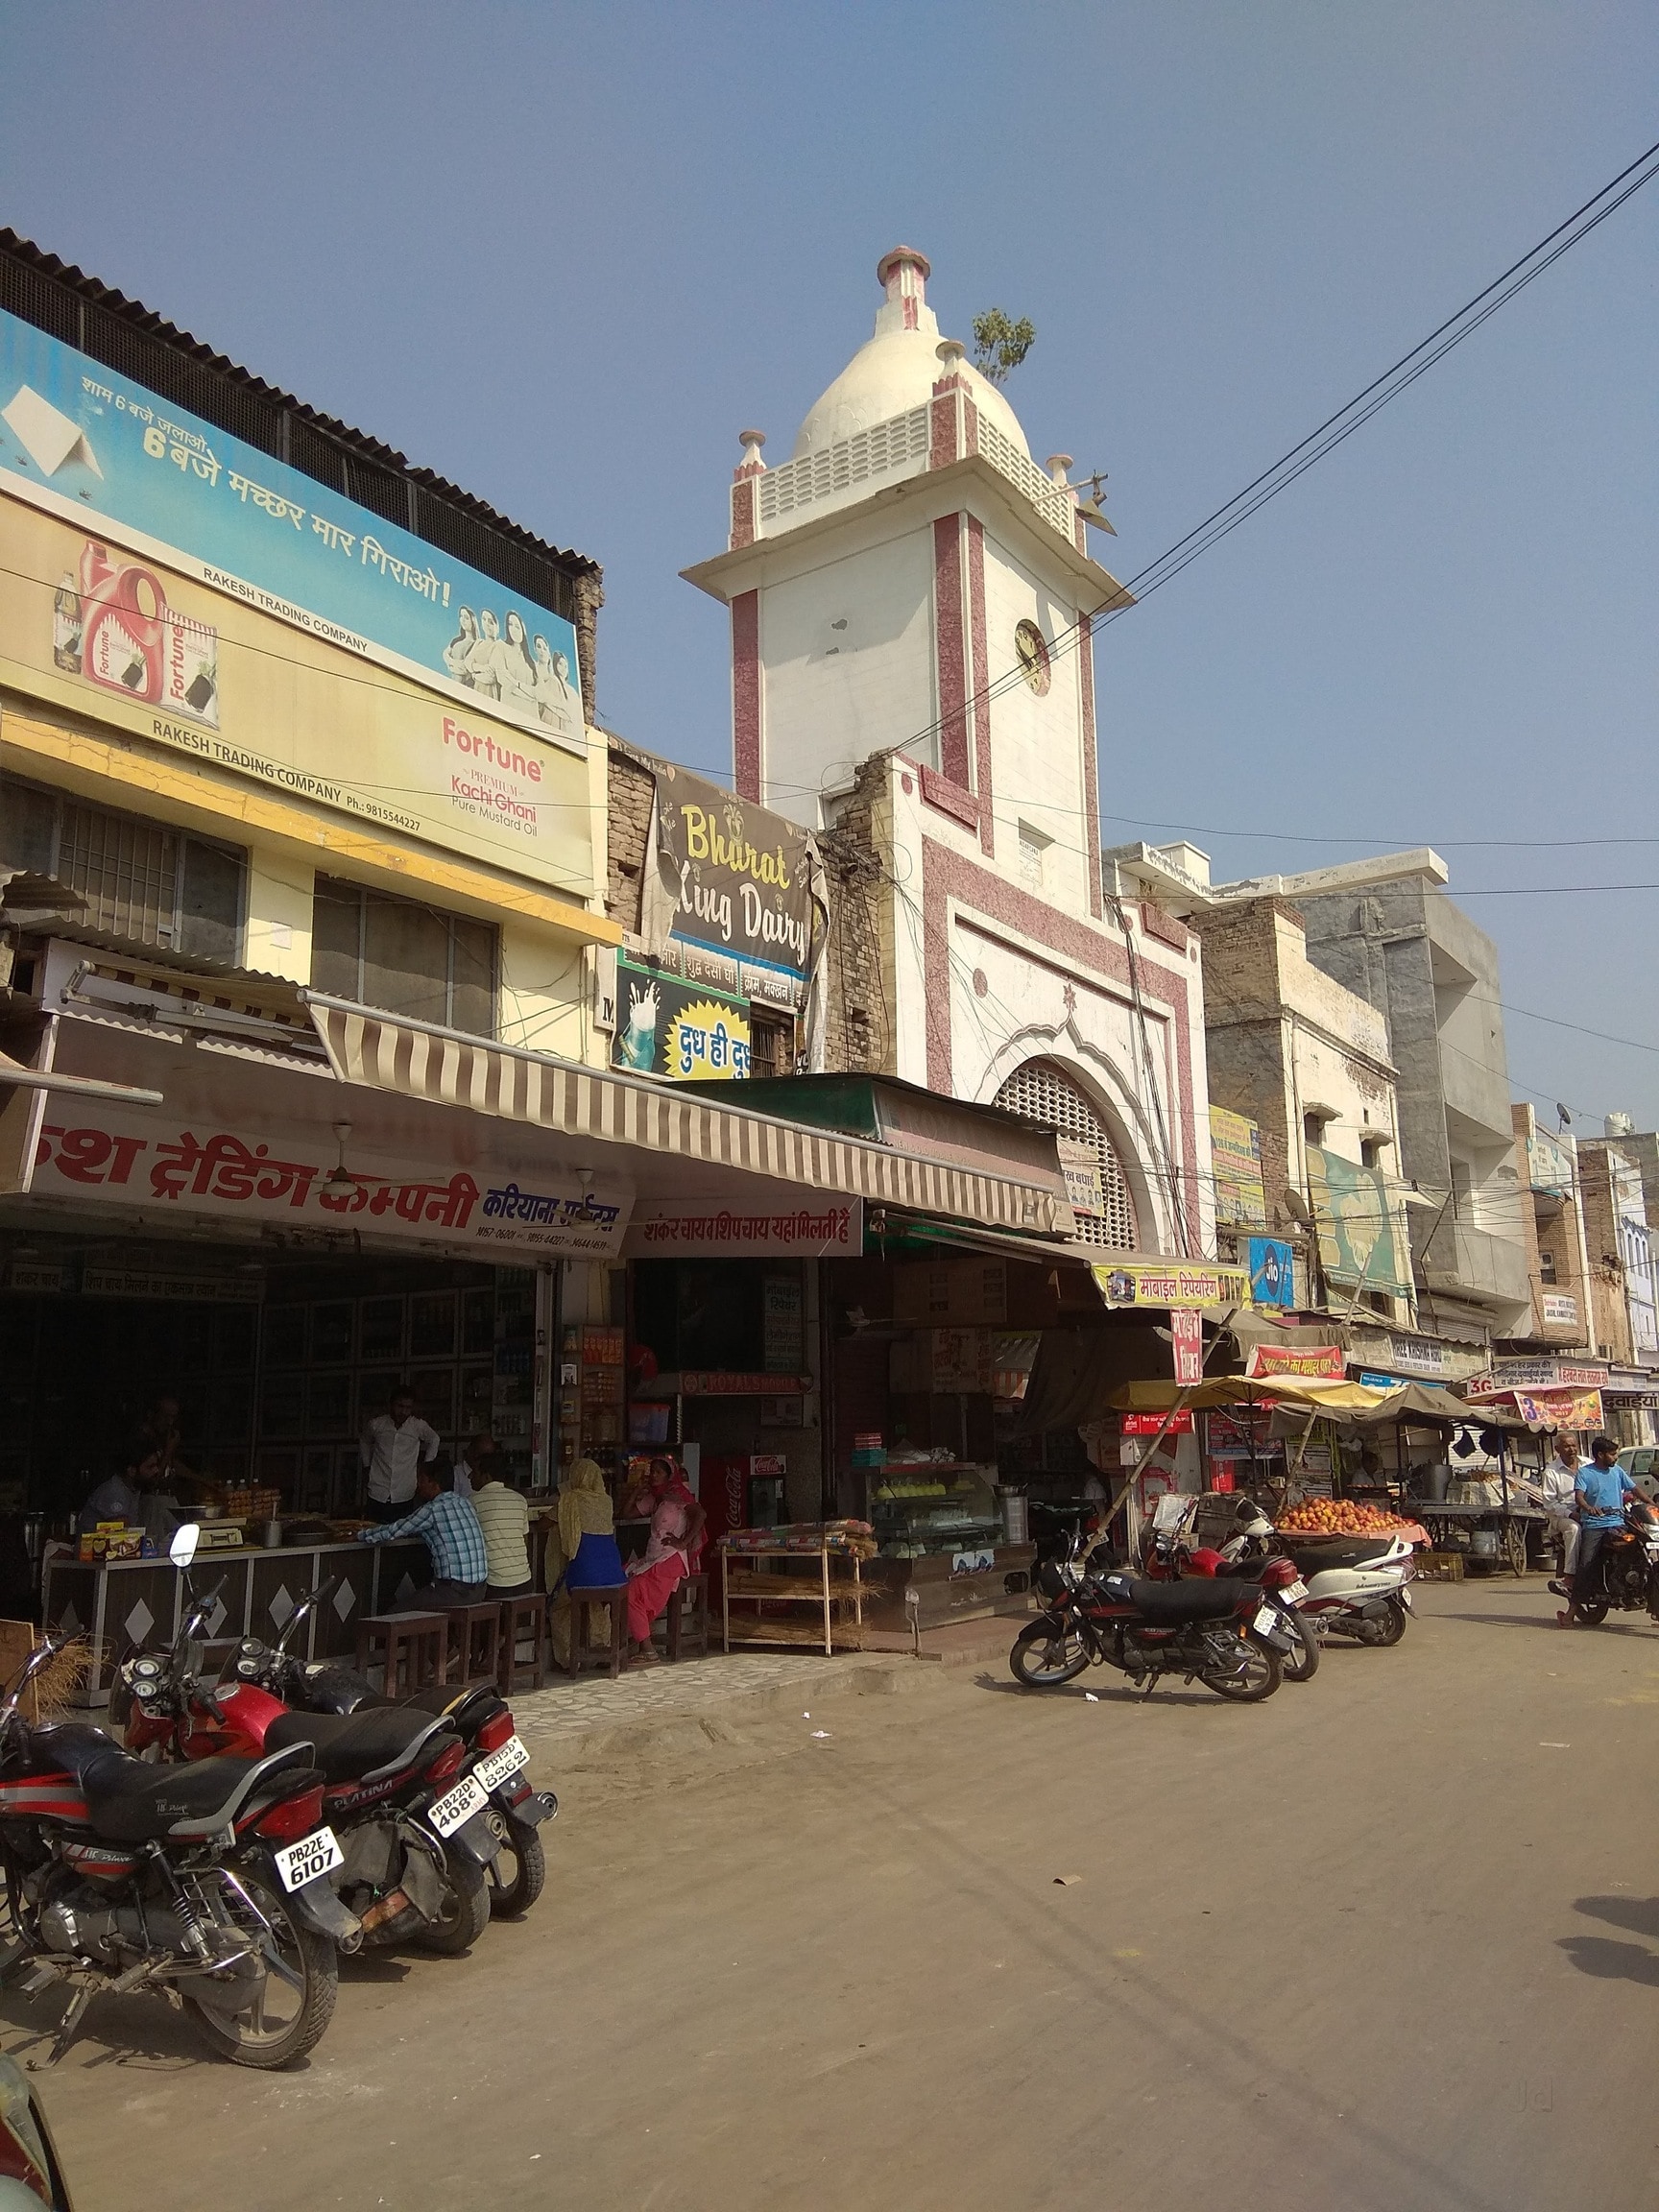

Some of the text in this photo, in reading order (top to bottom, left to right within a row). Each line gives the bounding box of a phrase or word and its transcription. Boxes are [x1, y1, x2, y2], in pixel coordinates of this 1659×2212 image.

[82, 376, 113, 402] शाम
[115, 395, 126, 410] 6
[129, 401, 155, 424] बजे
[144, 426, 166, 459] 6
[170, 440, 222, 488] बजे
[228, 469, 305, 531] मच्छर
[311, 514, 356, 558] मार
[204, 567, 368, 653] RAKESH TRADING COMPANY
[100, 630, 110, 676] Fortune
[170, 623, 185, 702] Fortune
[443, 716, 542, 782] Fortune
[153, 720, 210, 754] RAKESH
[212, 742, 275, 779] TRADING
[276, 768, 342, 803] COMPANY
[366, 803, 421, 831] 9815544227
[470, 769, 517, 797] PREMIUM
[451, 774, 537, 824] Kachi Ghani
[452, 796, 538, 837] Pure Mustard Oil
[681, 804, 791, 890] Bharat
[738, 882, 805, 967] Dairy
[709, 1022, 728, 1068] ही
[150, 1131, 320, 1208] ट्रेडिंग
[1470, 1379, 1492, 1393] 3G
[481, 1743, 517, 1773] PB15D
[485, 1750, 527, 1788] 8262
[334, 1779, 393, 1809] PLATINA
[436, 1783, 471, 1816] PB22D
[288, 1834, 325, 1867] PB22E
[290, 1848, 334, 1887] 6107
